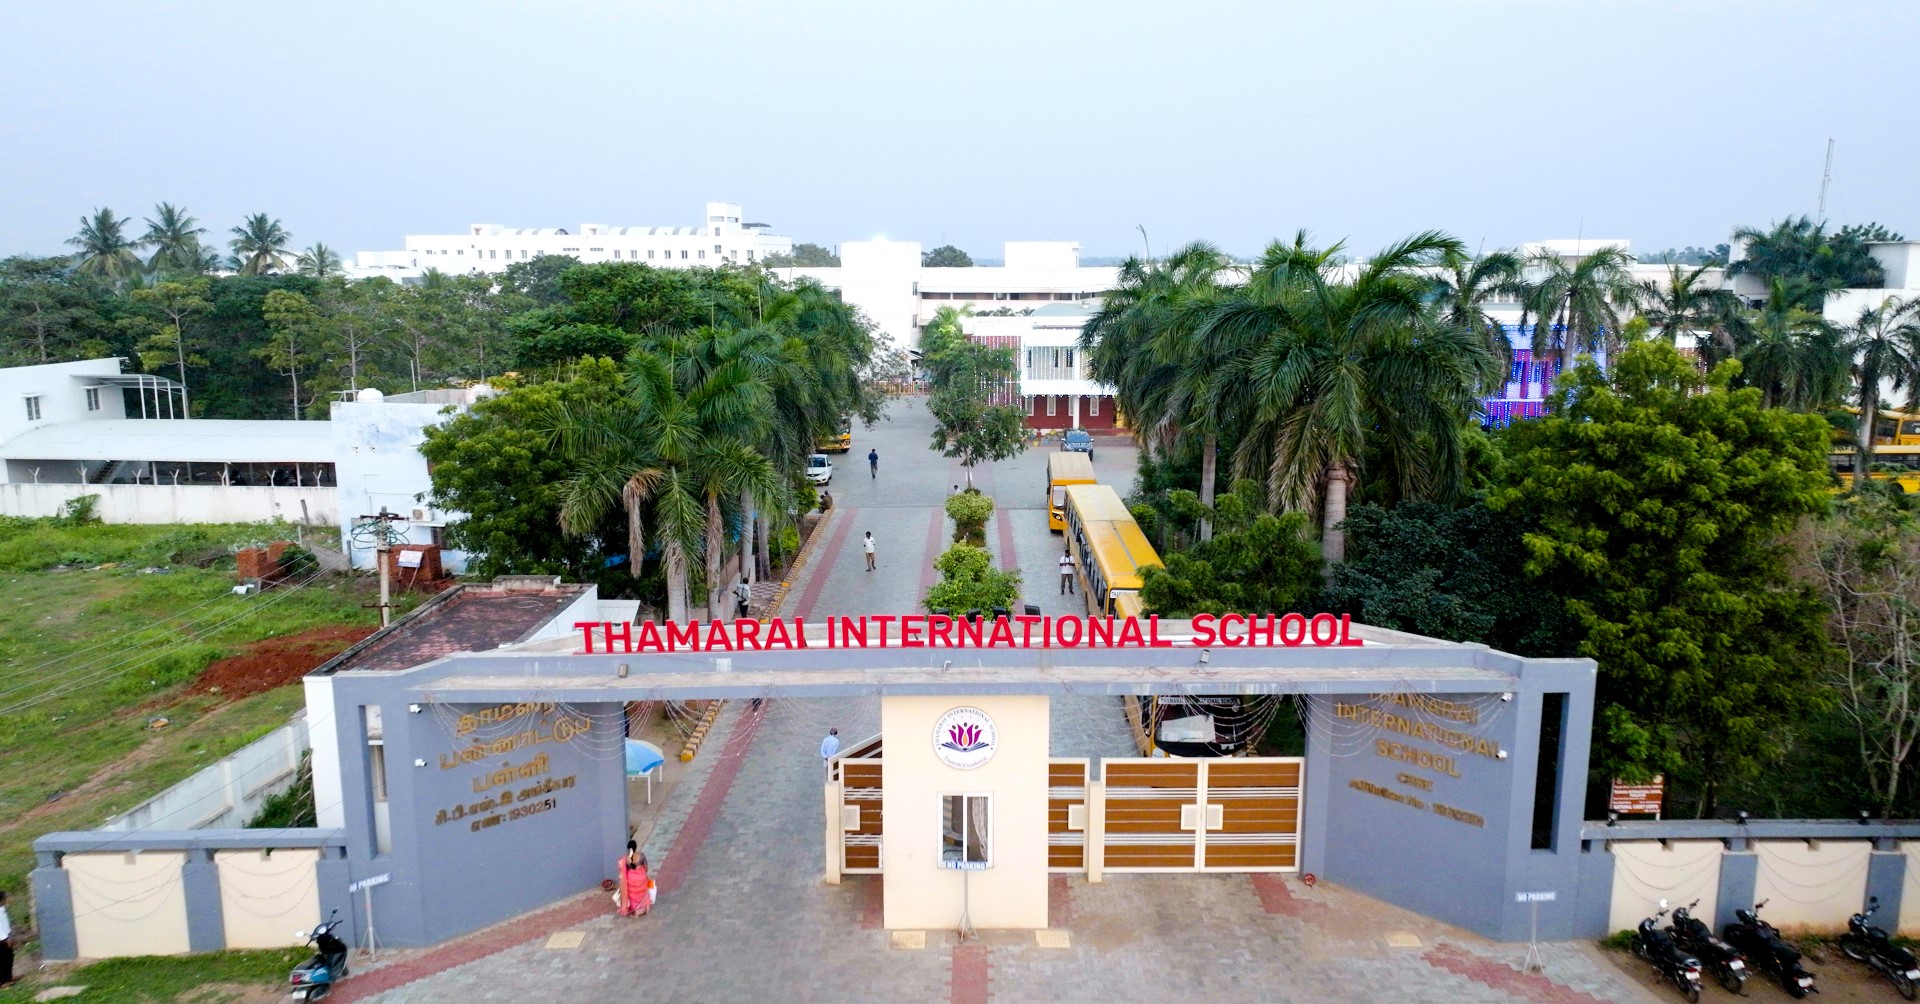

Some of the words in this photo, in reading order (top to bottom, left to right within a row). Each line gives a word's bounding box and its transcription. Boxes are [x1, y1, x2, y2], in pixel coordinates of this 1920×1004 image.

[574, 616, 804, 655] THAMARAI
[827, 614, 1173, 649] INTERNATIONAL
[1191, 612, 1364, 648] SCHOOL
[1375, 738, 1462, 779] SCHOOL
[957, 861, 986, 870] PARKING
[358, 873, 389, 889] PARKING
[1528, 891, 1556, 901] PARKING
